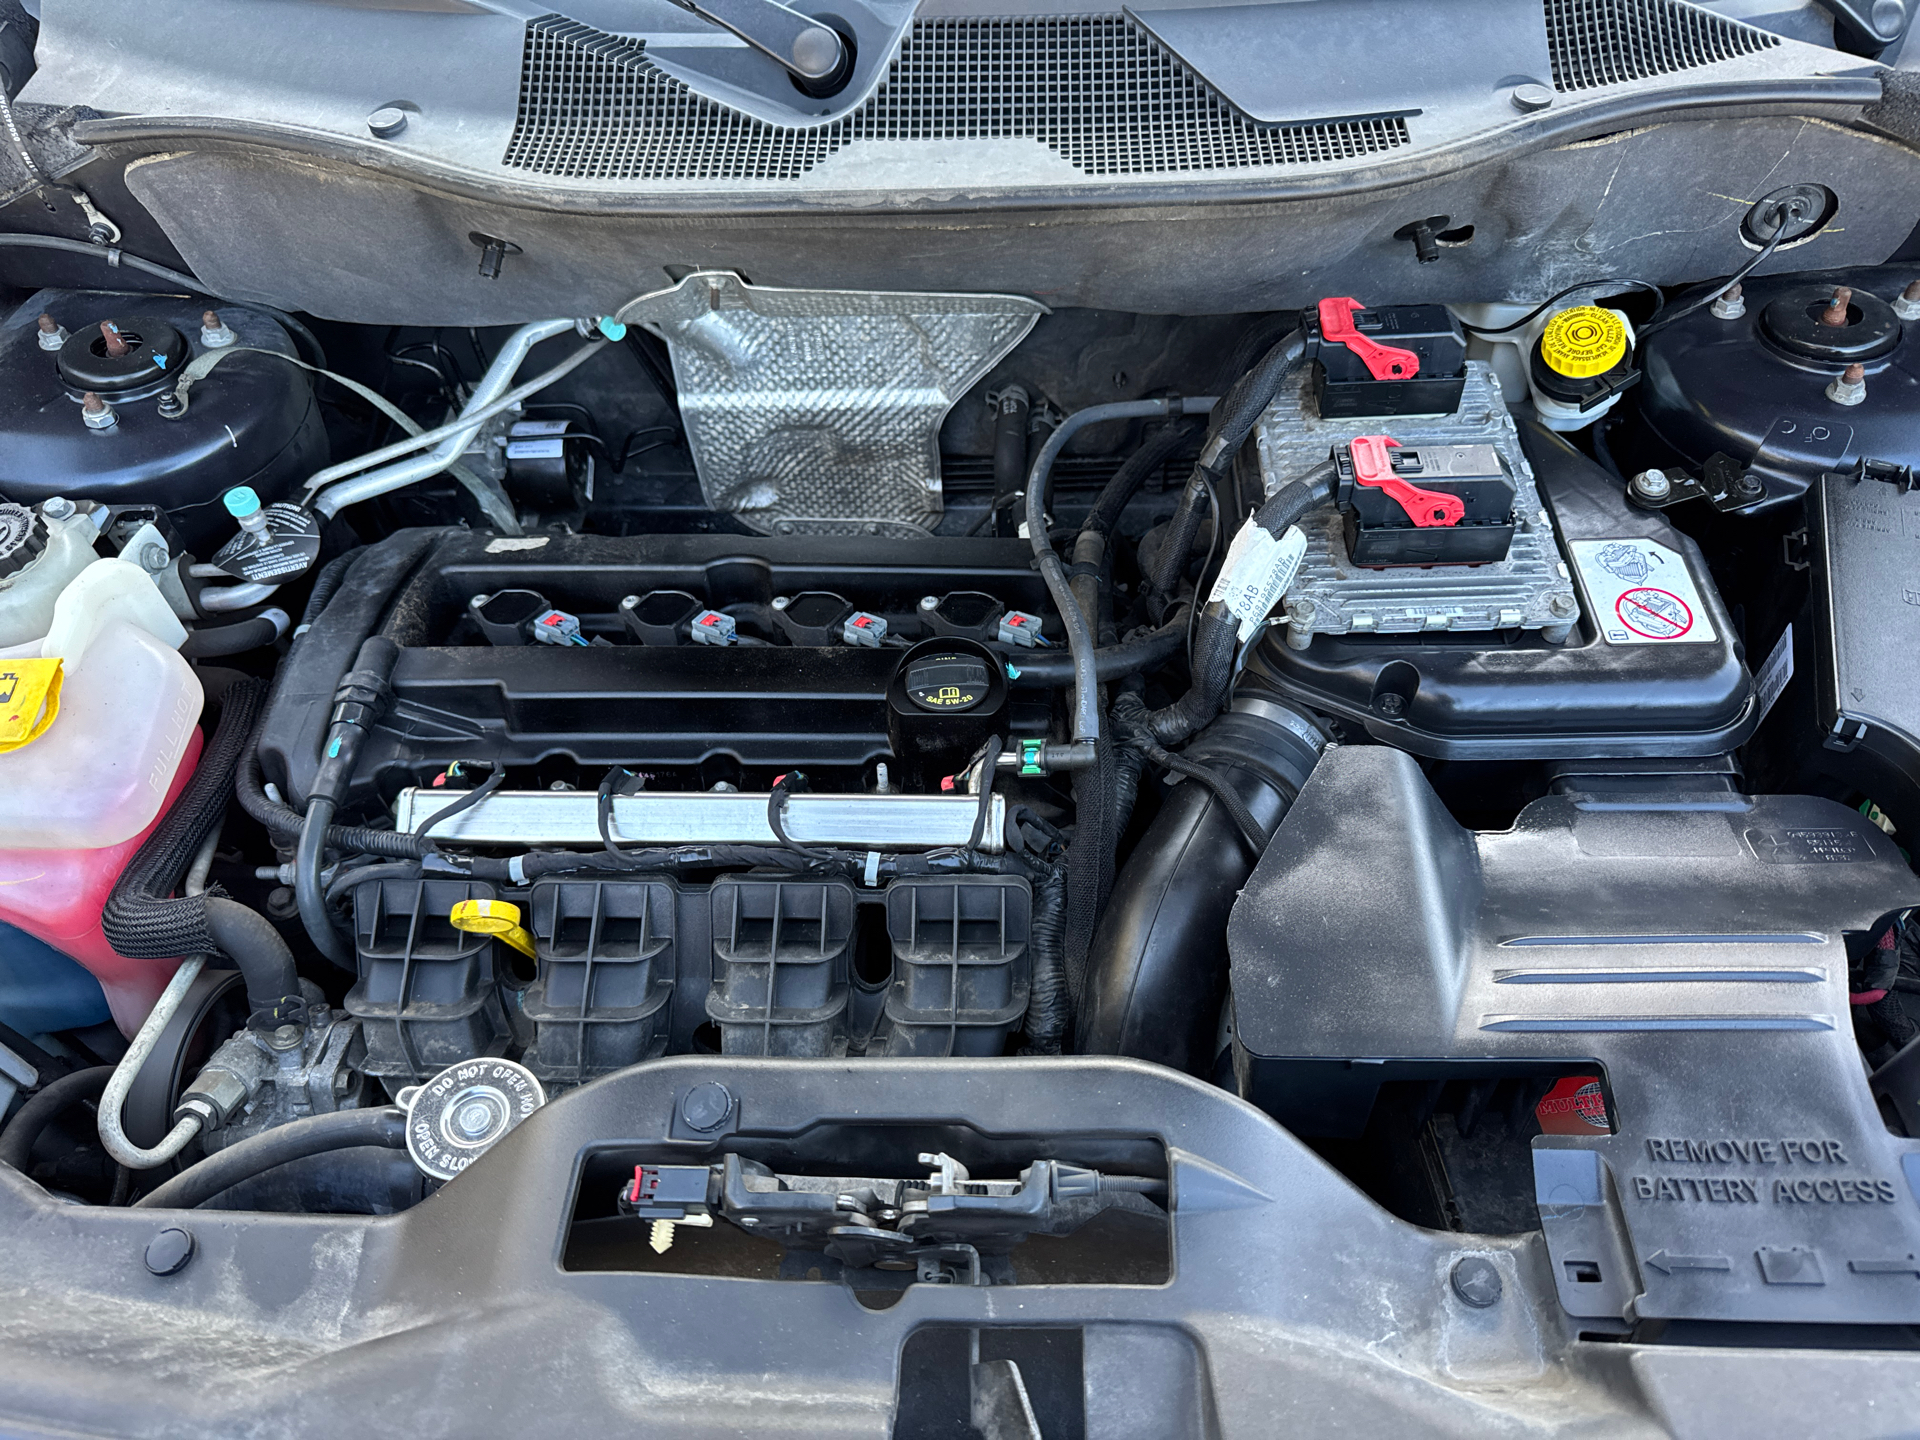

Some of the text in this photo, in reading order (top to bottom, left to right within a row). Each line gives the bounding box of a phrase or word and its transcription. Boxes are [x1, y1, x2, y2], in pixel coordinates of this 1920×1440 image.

[1567, 348, 1594, 356] BEFORE
[251, 561, 308, 581] AVERTISSEMENT!
[926, 694, 974, 705] SAE 5W-20
[148, 681, 192, 793] FULL HOT
[431, 1077, 454, 1097] DO
[457, 1064, 488, 1080] NOT
[492, 1066, 528, 1092] OPEN
[414, 1122, 440, 1160] OPEN
[1647, 1137, 1849, 1165] REMOVE FOR
[1633, 1175, 1896, 1204] BATTERY ACCESS
